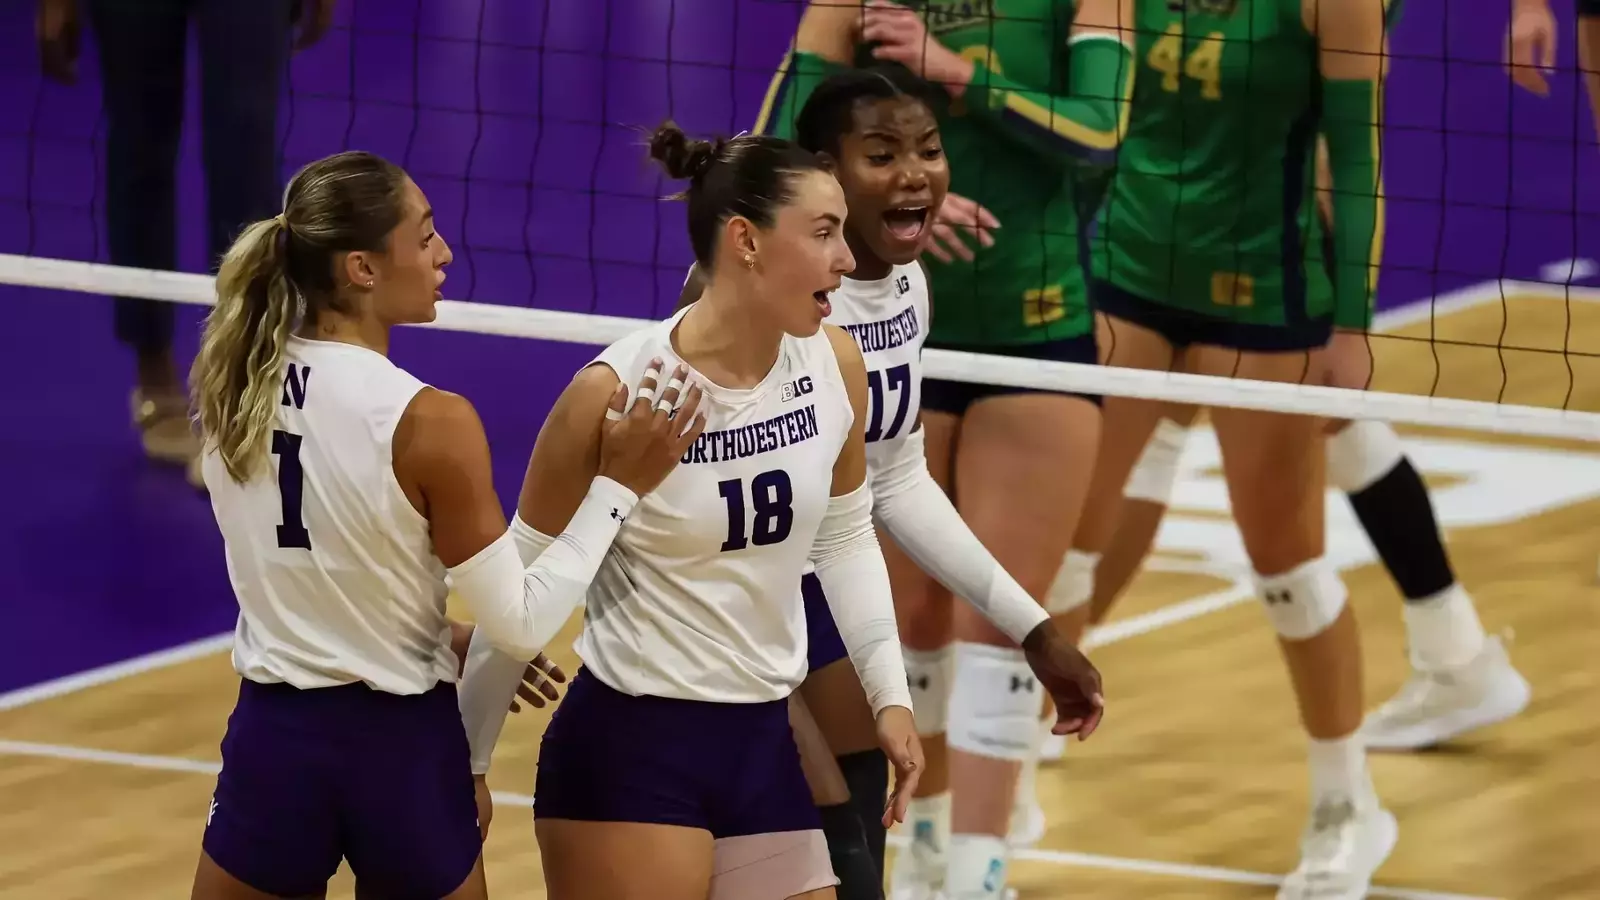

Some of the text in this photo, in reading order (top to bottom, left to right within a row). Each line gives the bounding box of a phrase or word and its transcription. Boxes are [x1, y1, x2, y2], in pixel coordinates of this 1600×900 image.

[1147, 21, 1225, 100] 44
[839, 305, 920, 353] THWESTERN
[281, 363, 311, 410] N
[864, 363, 911, 443] 17
[679, 404, 819, 464] ORTHWESTERN
[271, 429, 312, 551] 1
[718, 469, 793, 552] 18
